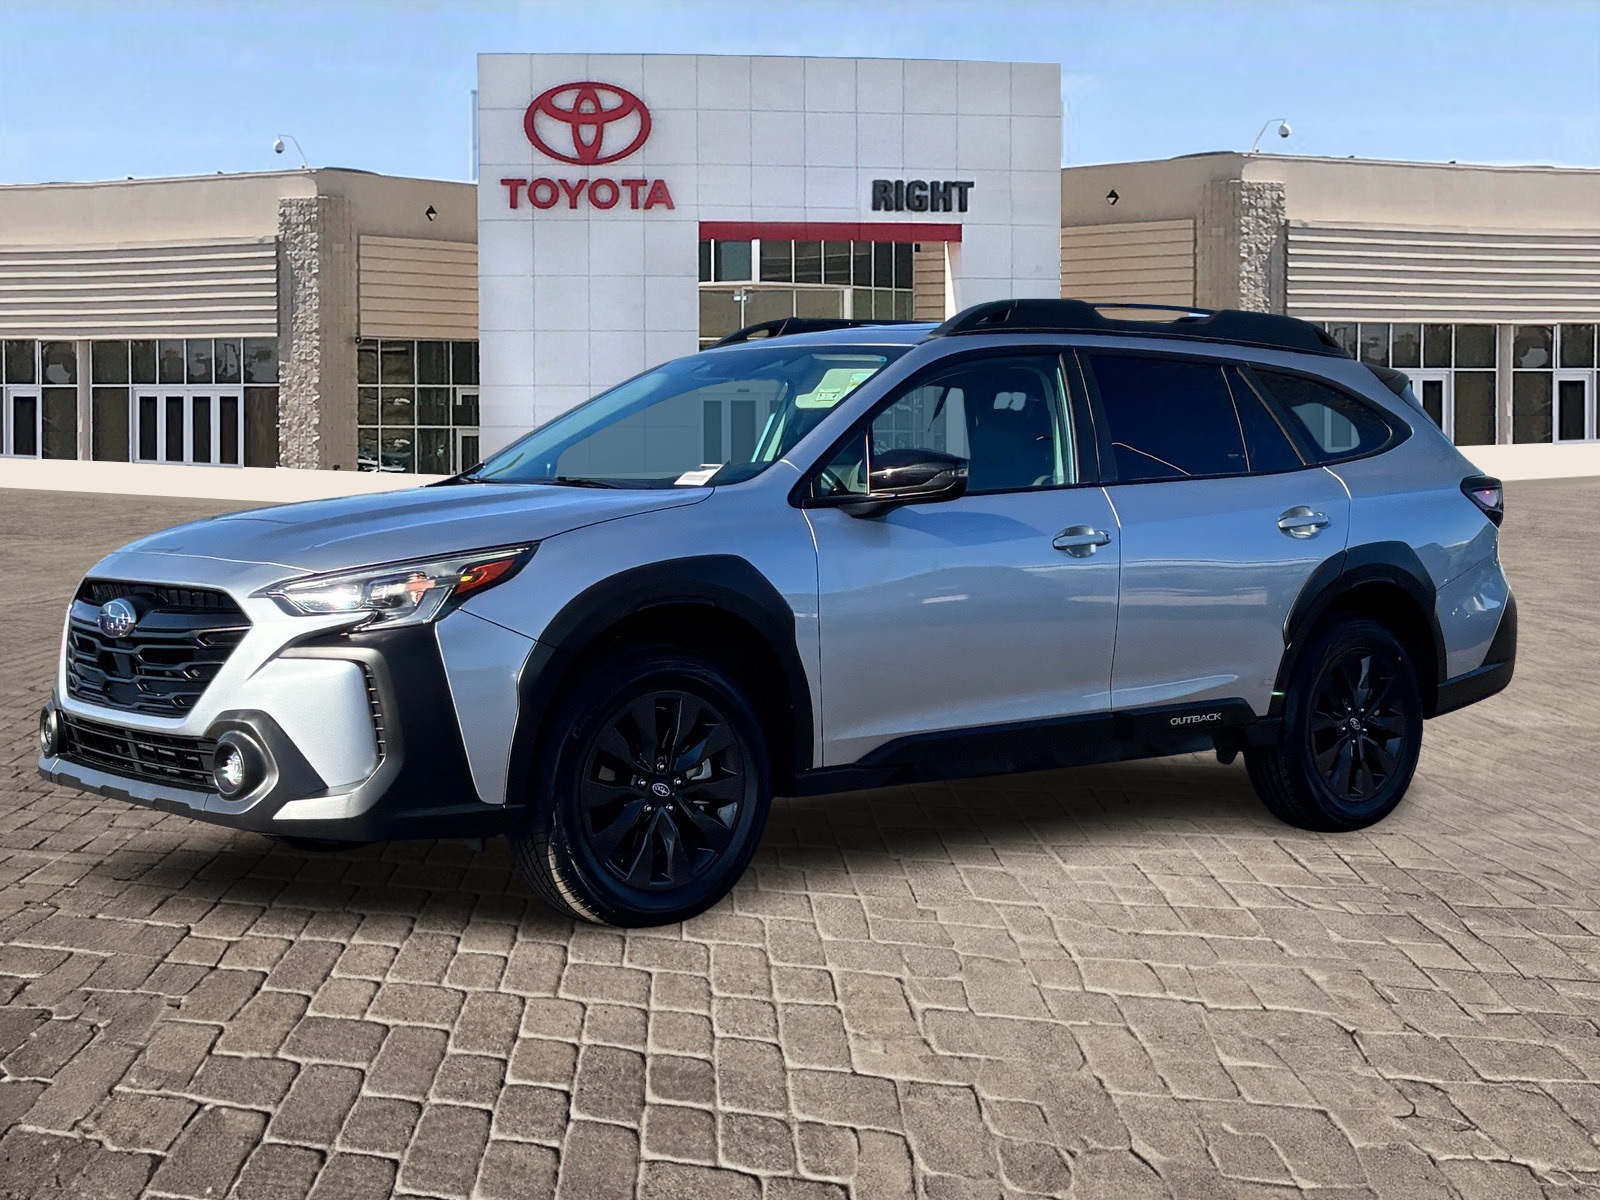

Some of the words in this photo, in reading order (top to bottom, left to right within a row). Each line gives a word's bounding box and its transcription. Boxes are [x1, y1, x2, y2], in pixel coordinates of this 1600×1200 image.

[501, 178, 675, 210] TOYOTA
[872, 180, 974, 212] RIGHT
[1170, 712, 1222, 726] OUTBACK
